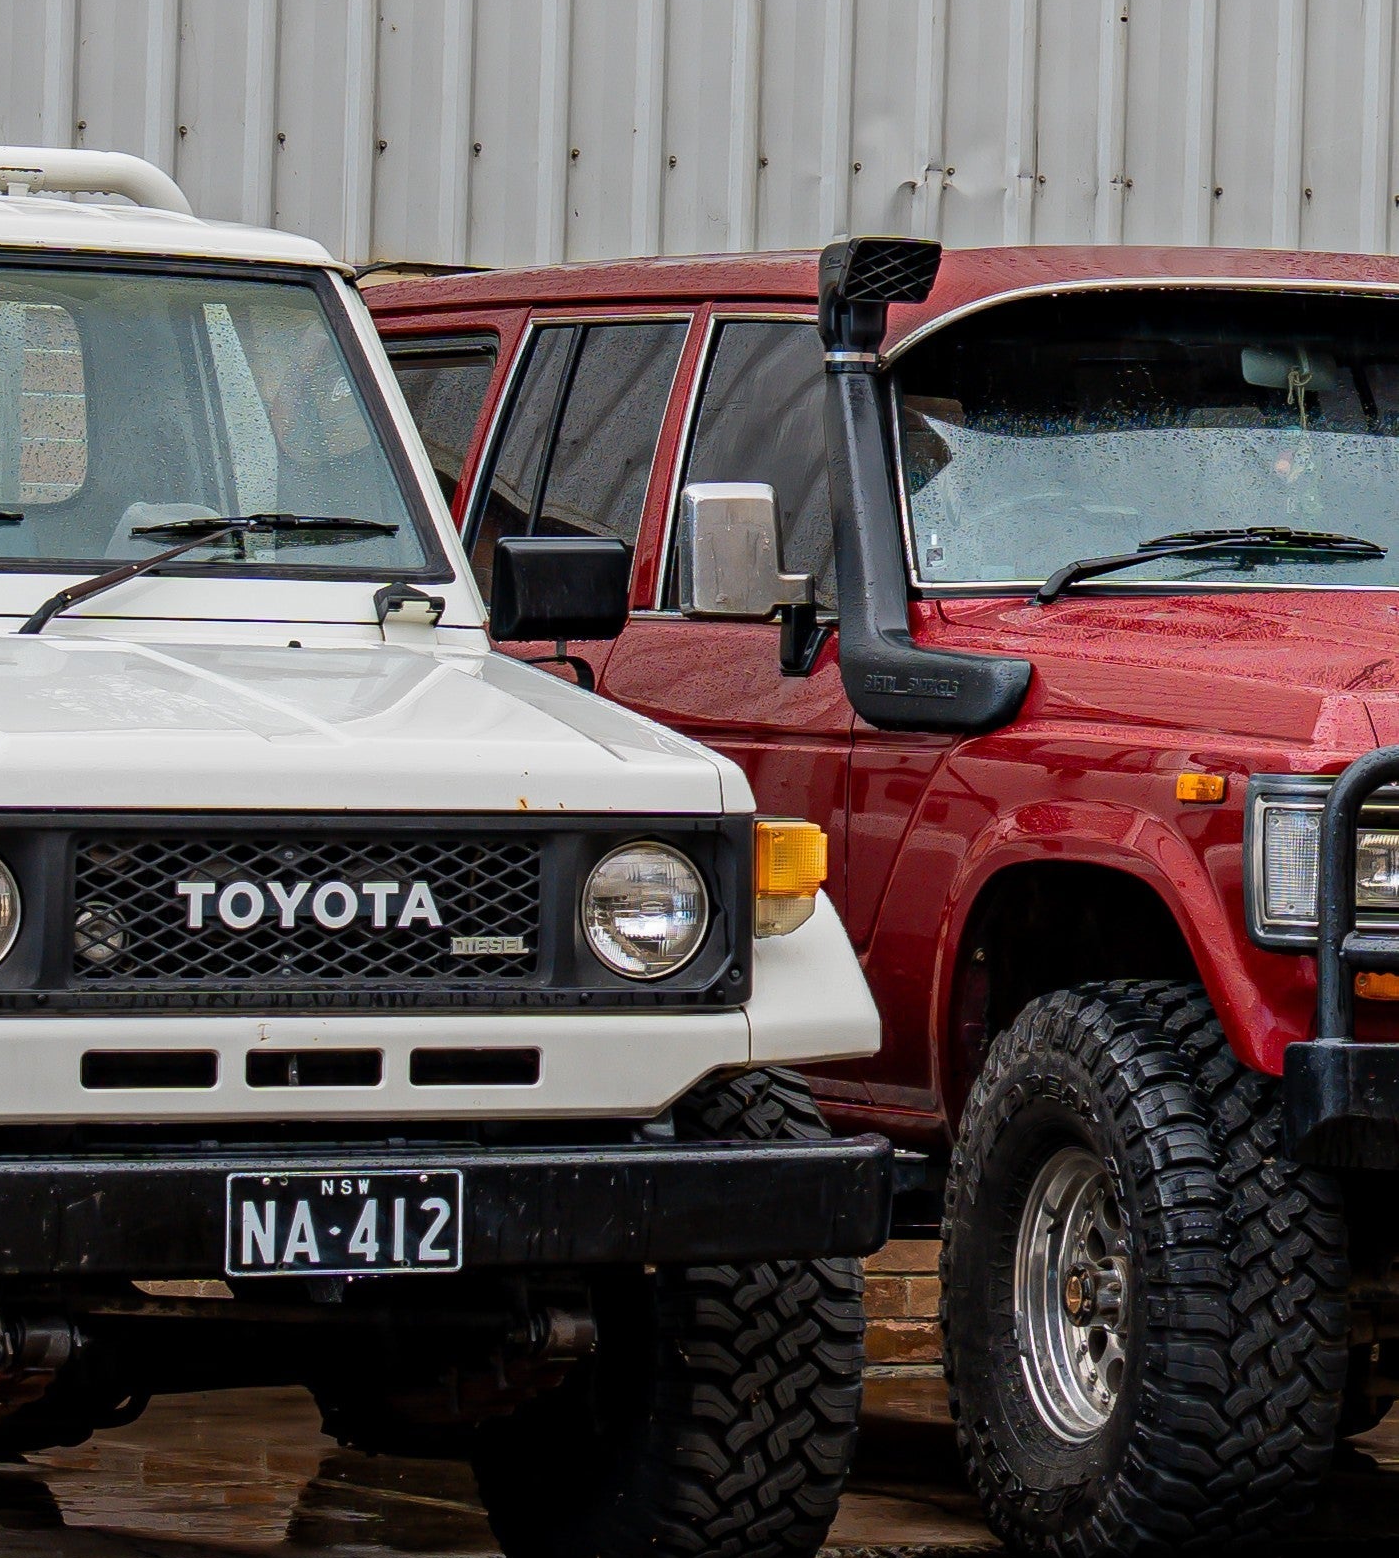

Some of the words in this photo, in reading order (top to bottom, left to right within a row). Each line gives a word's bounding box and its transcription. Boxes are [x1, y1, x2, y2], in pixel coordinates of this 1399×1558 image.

[177, 881, 443, 929] TOYOTA
[451, 936, 530, 955] DIESEL
[321, 1179, 370, 1195] NSW
